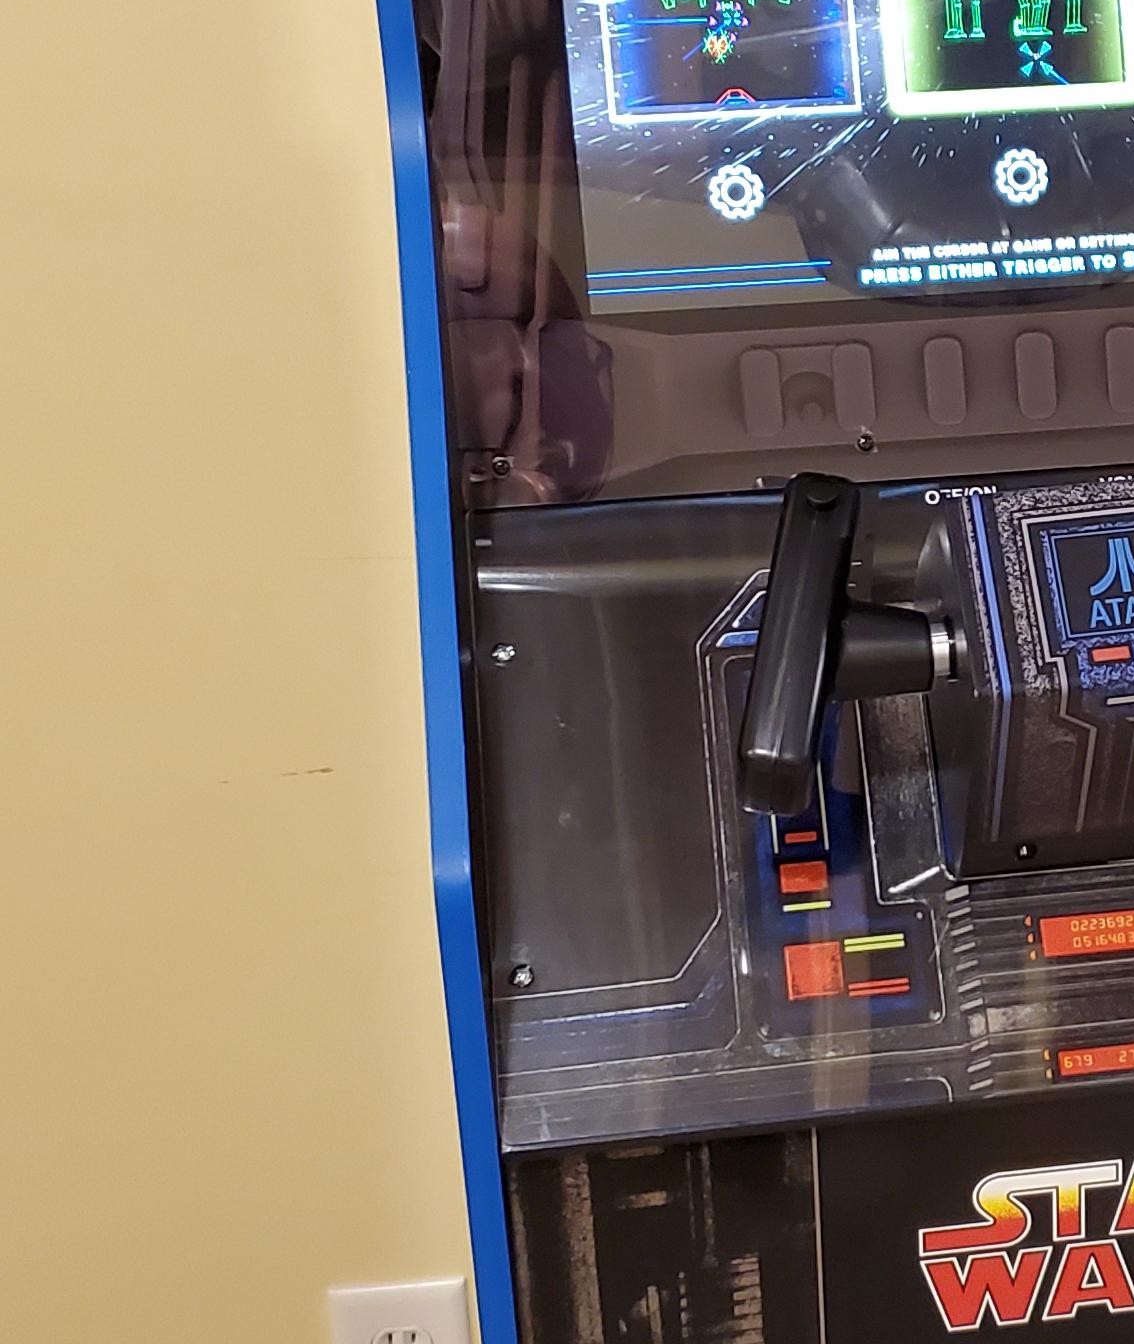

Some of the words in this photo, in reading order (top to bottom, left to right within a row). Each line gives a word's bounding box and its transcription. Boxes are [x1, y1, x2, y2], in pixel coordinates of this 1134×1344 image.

[901, 245, 931, 260] THE
[933, 242, 990, 258] CURSOR
[991, 240, 1010, 255] AT
[1055, 236, 1076, 251] OR
[860, 265, 924, 285] PRESS
[928, 260, 999, 281] EITHER
[1002, 255, 1087, 276] TRIGGER
[1091, 253, 1117, 271] TO
[1063, 1054, 1094, 1069] 679
